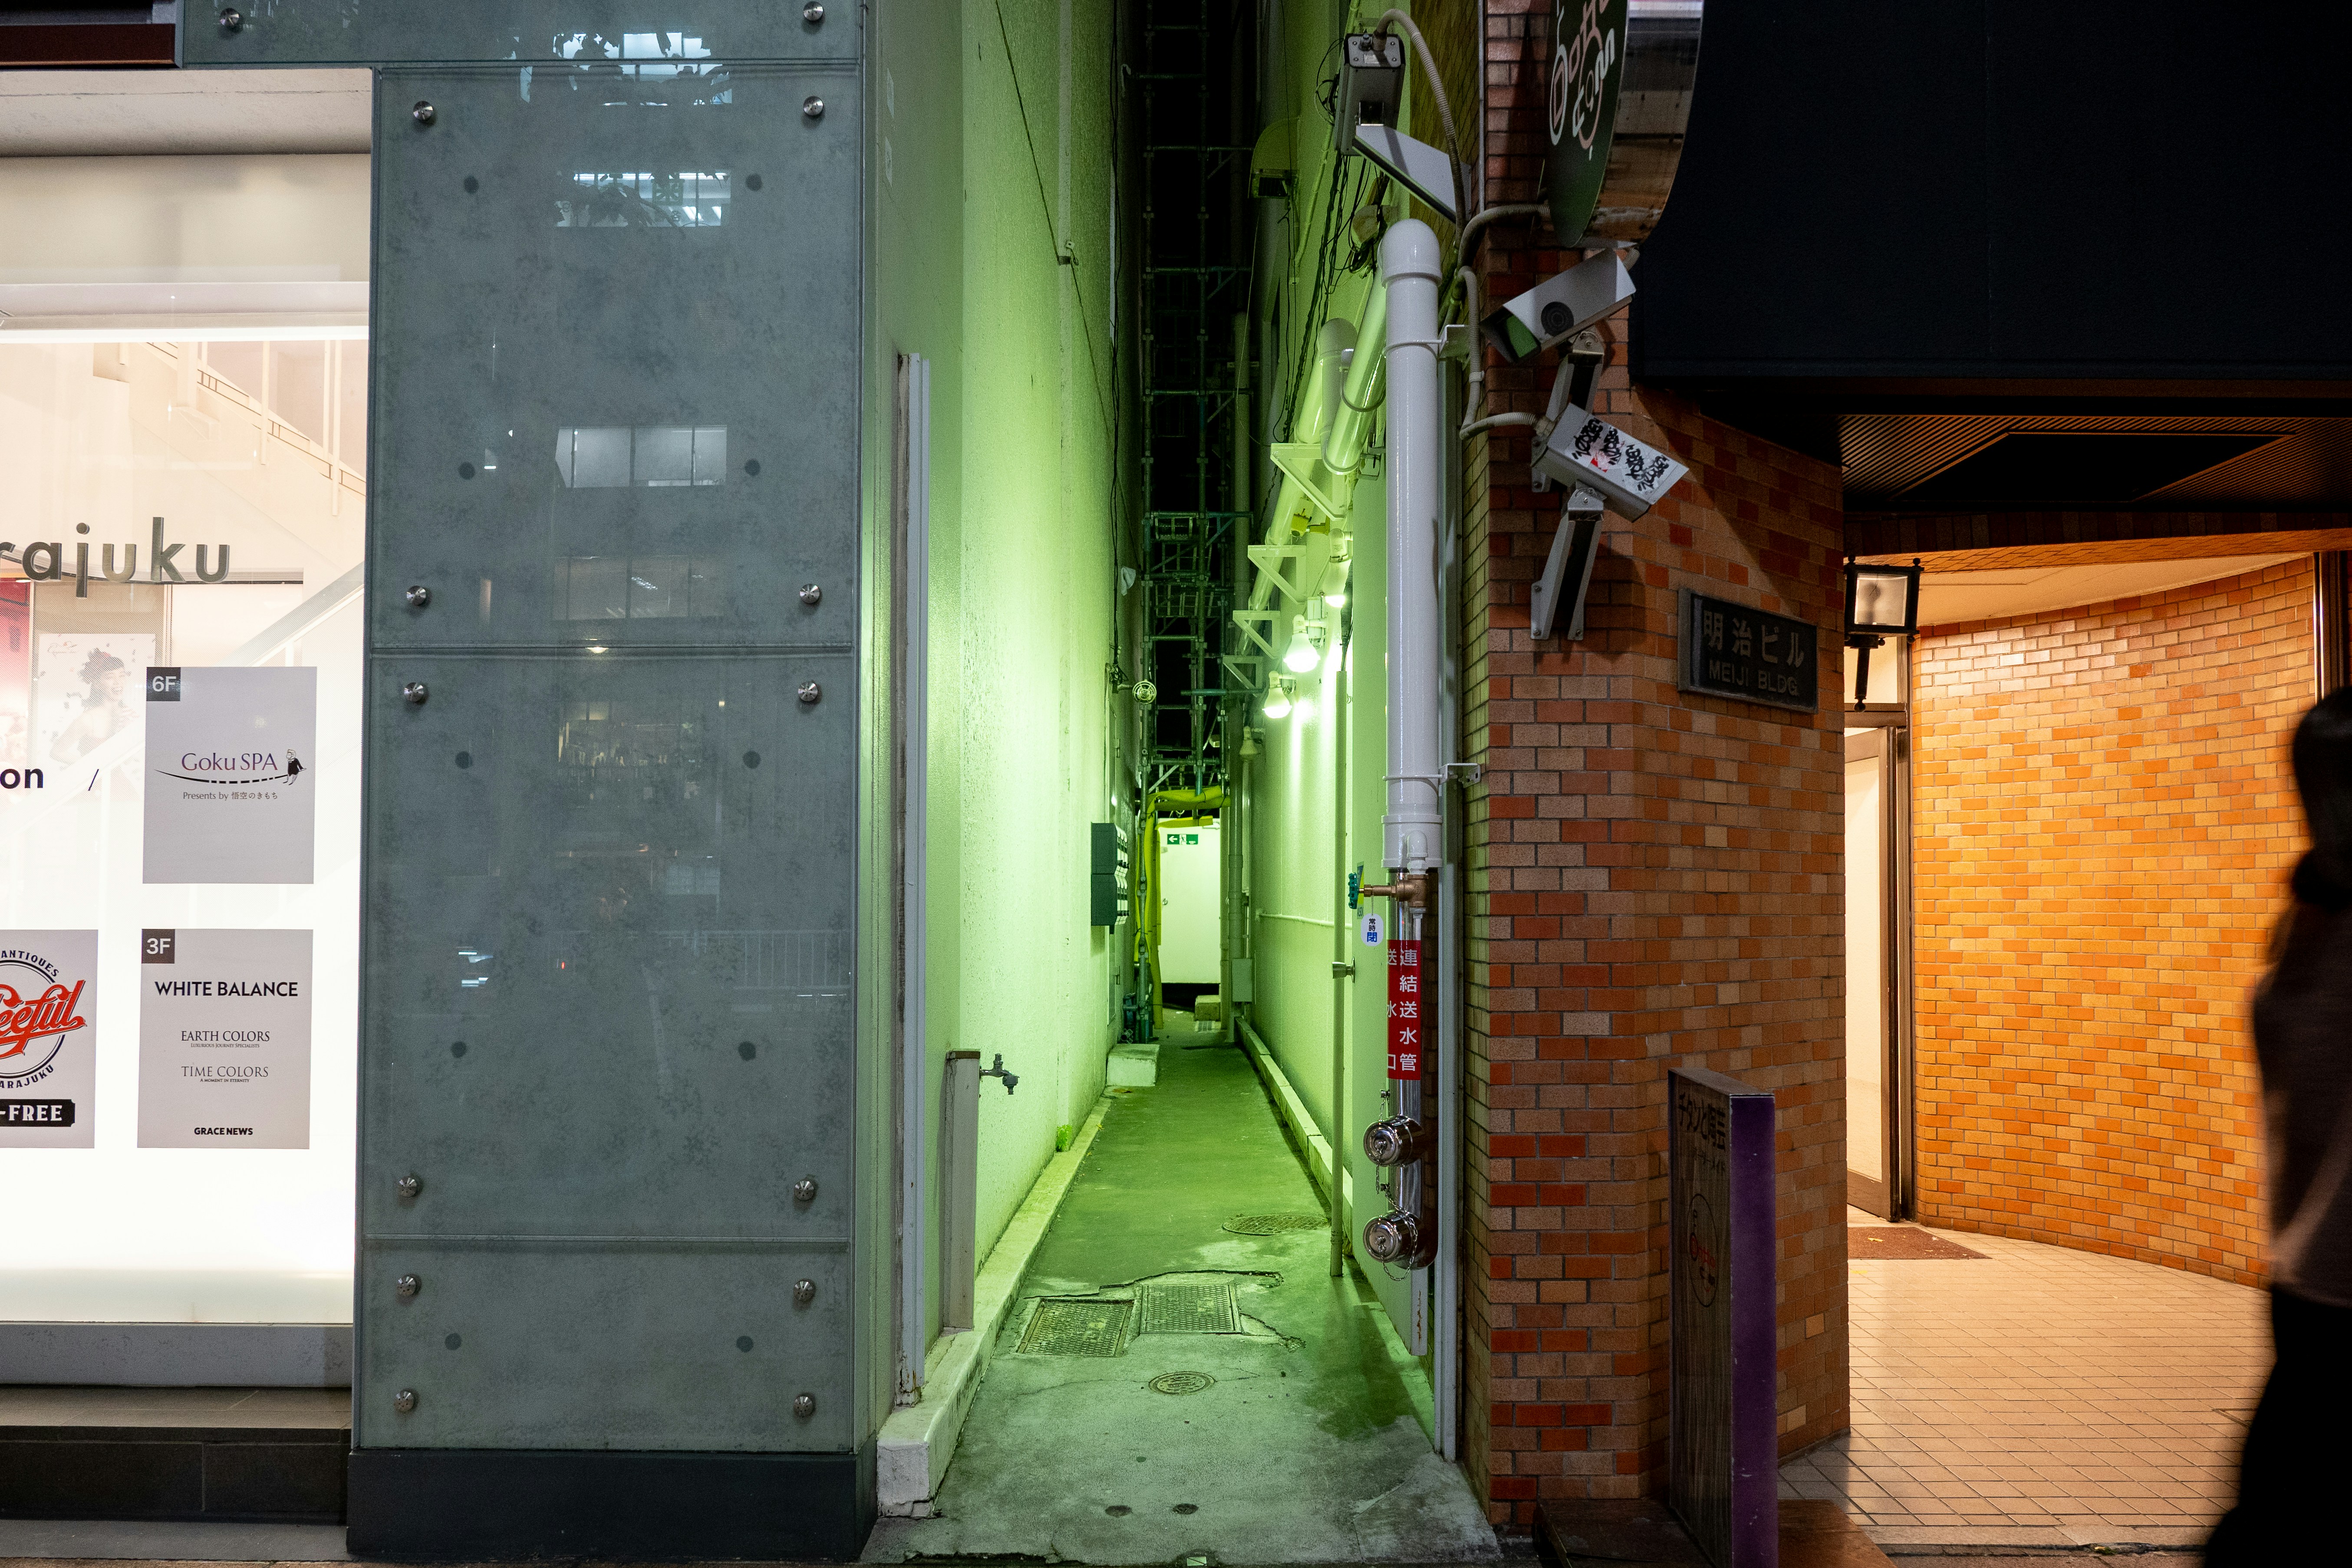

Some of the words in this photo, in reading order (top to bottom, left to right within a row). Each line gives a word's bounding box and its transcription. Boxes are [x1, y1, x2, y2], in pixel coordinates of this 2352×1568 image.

[1703, 609, 1805, 668] 明治ビル
[152, 675, 177, 692] 6F
[1709, 659, 1749, 687] MEIJI
[1759, 670, 1799, 696] BLDG
[181, 753, 235, 771] Goku
[240, 753, 278, 771] SPA
[0, 768, 43, 789] on
[219, 792, 229, 801] by
[231, 791, 278, 800] 悟空のきもち
[1367, 918, 1377, 942] 常時閉
[146, 938, 171, 954] 3F
[155, 981, 212, 996] WHITE
[218, 981, 298, 996] BALANCE
[1399, 949, 1417, 1071] 連結送水管
[181, 1031, 219, 1041] EARTH
[223, 1031, 270, 1042] COLORS
[181, 1066, 212, 1077] TIME
[217, 1066, 268, 1077] COLORS
